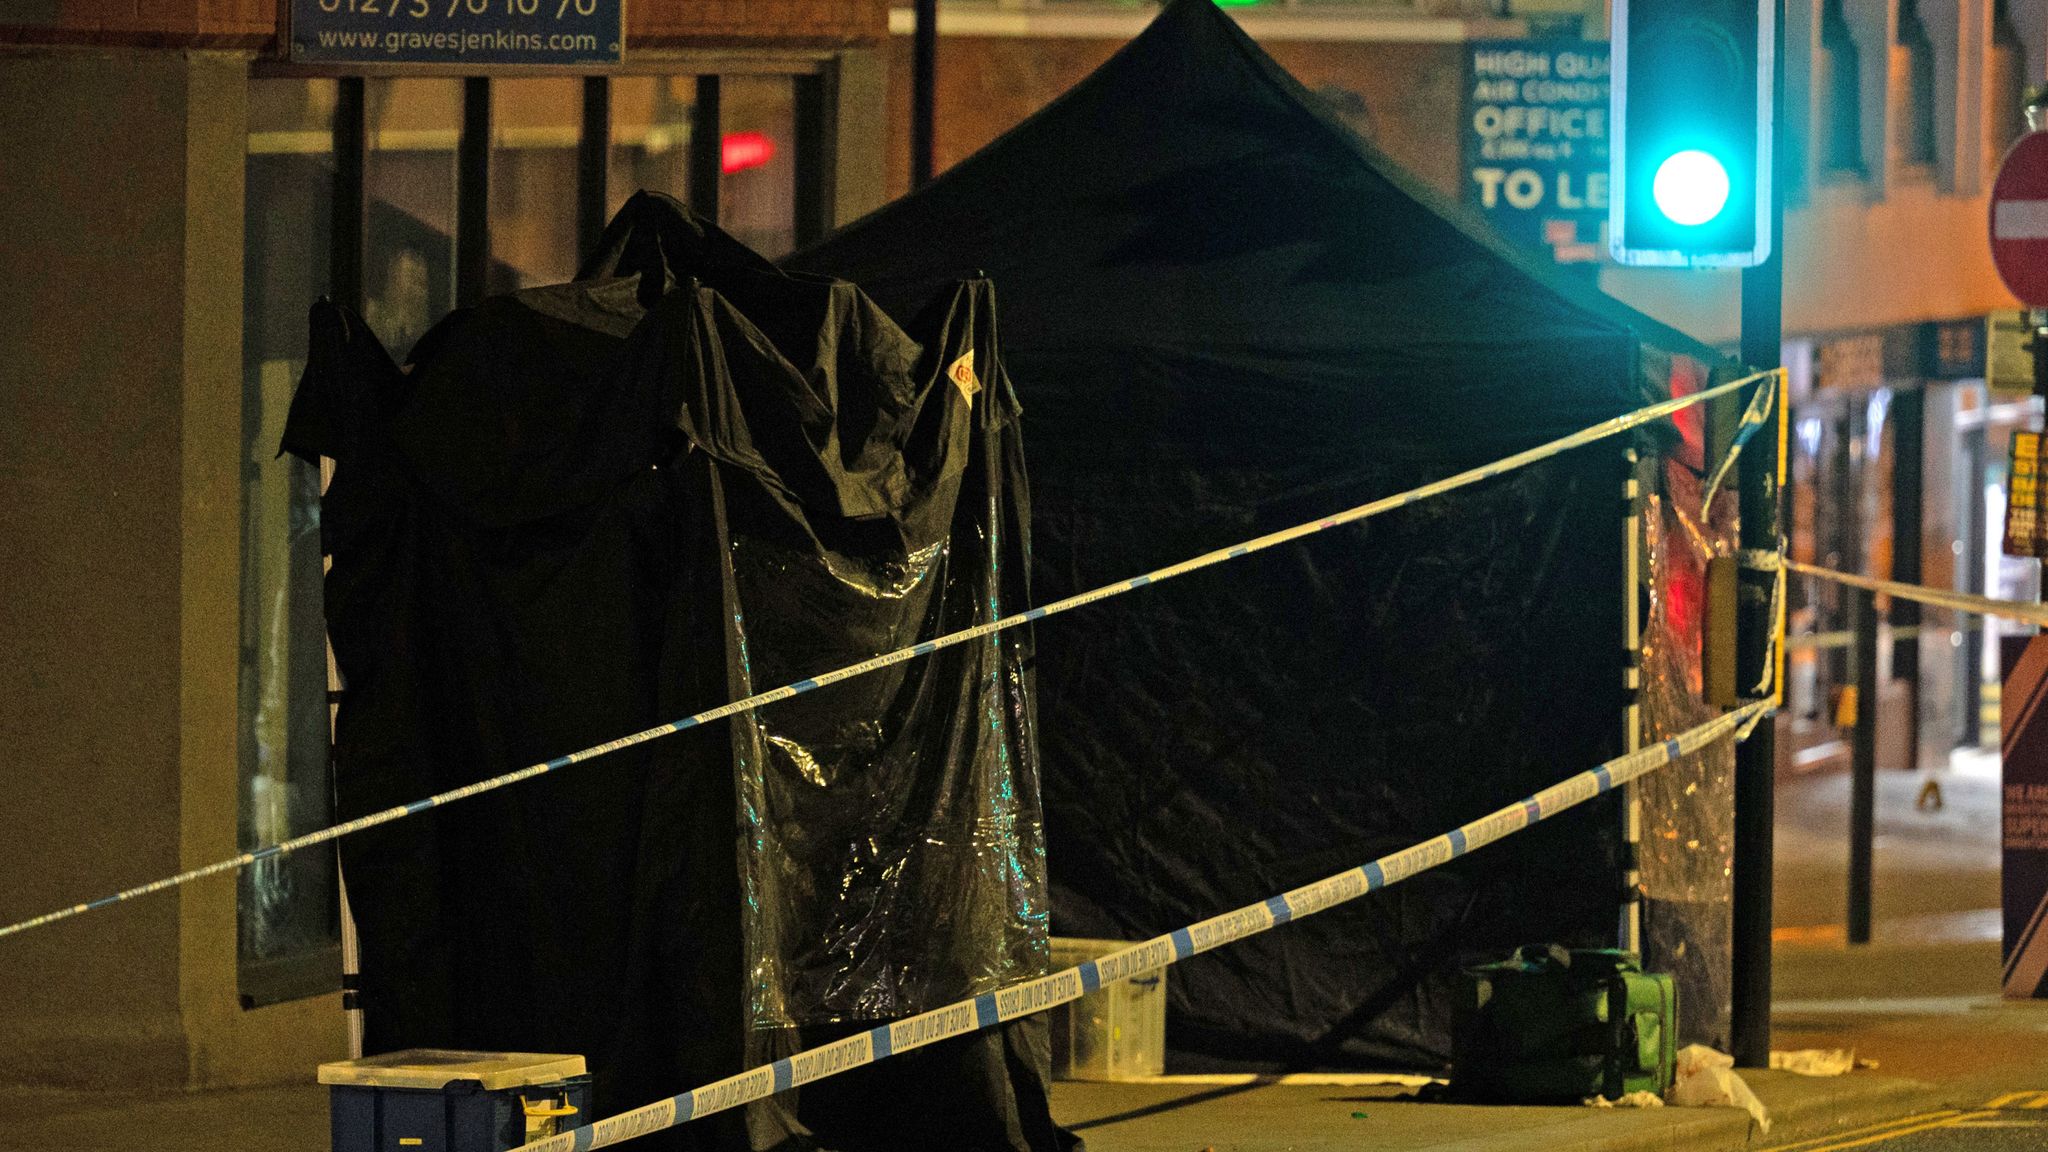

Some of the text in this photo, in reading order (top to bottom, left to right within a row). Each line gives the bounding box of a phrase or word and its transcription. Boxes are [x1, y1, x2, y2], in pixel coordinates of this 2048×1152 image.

[318, 29, 597, 54] www.gravesjenkins.com
[1474, 51, 1549, 77] HIGH
[1473, 105, 1606, 138] OFFICE
[1472, 167, 1545, 210] TO
